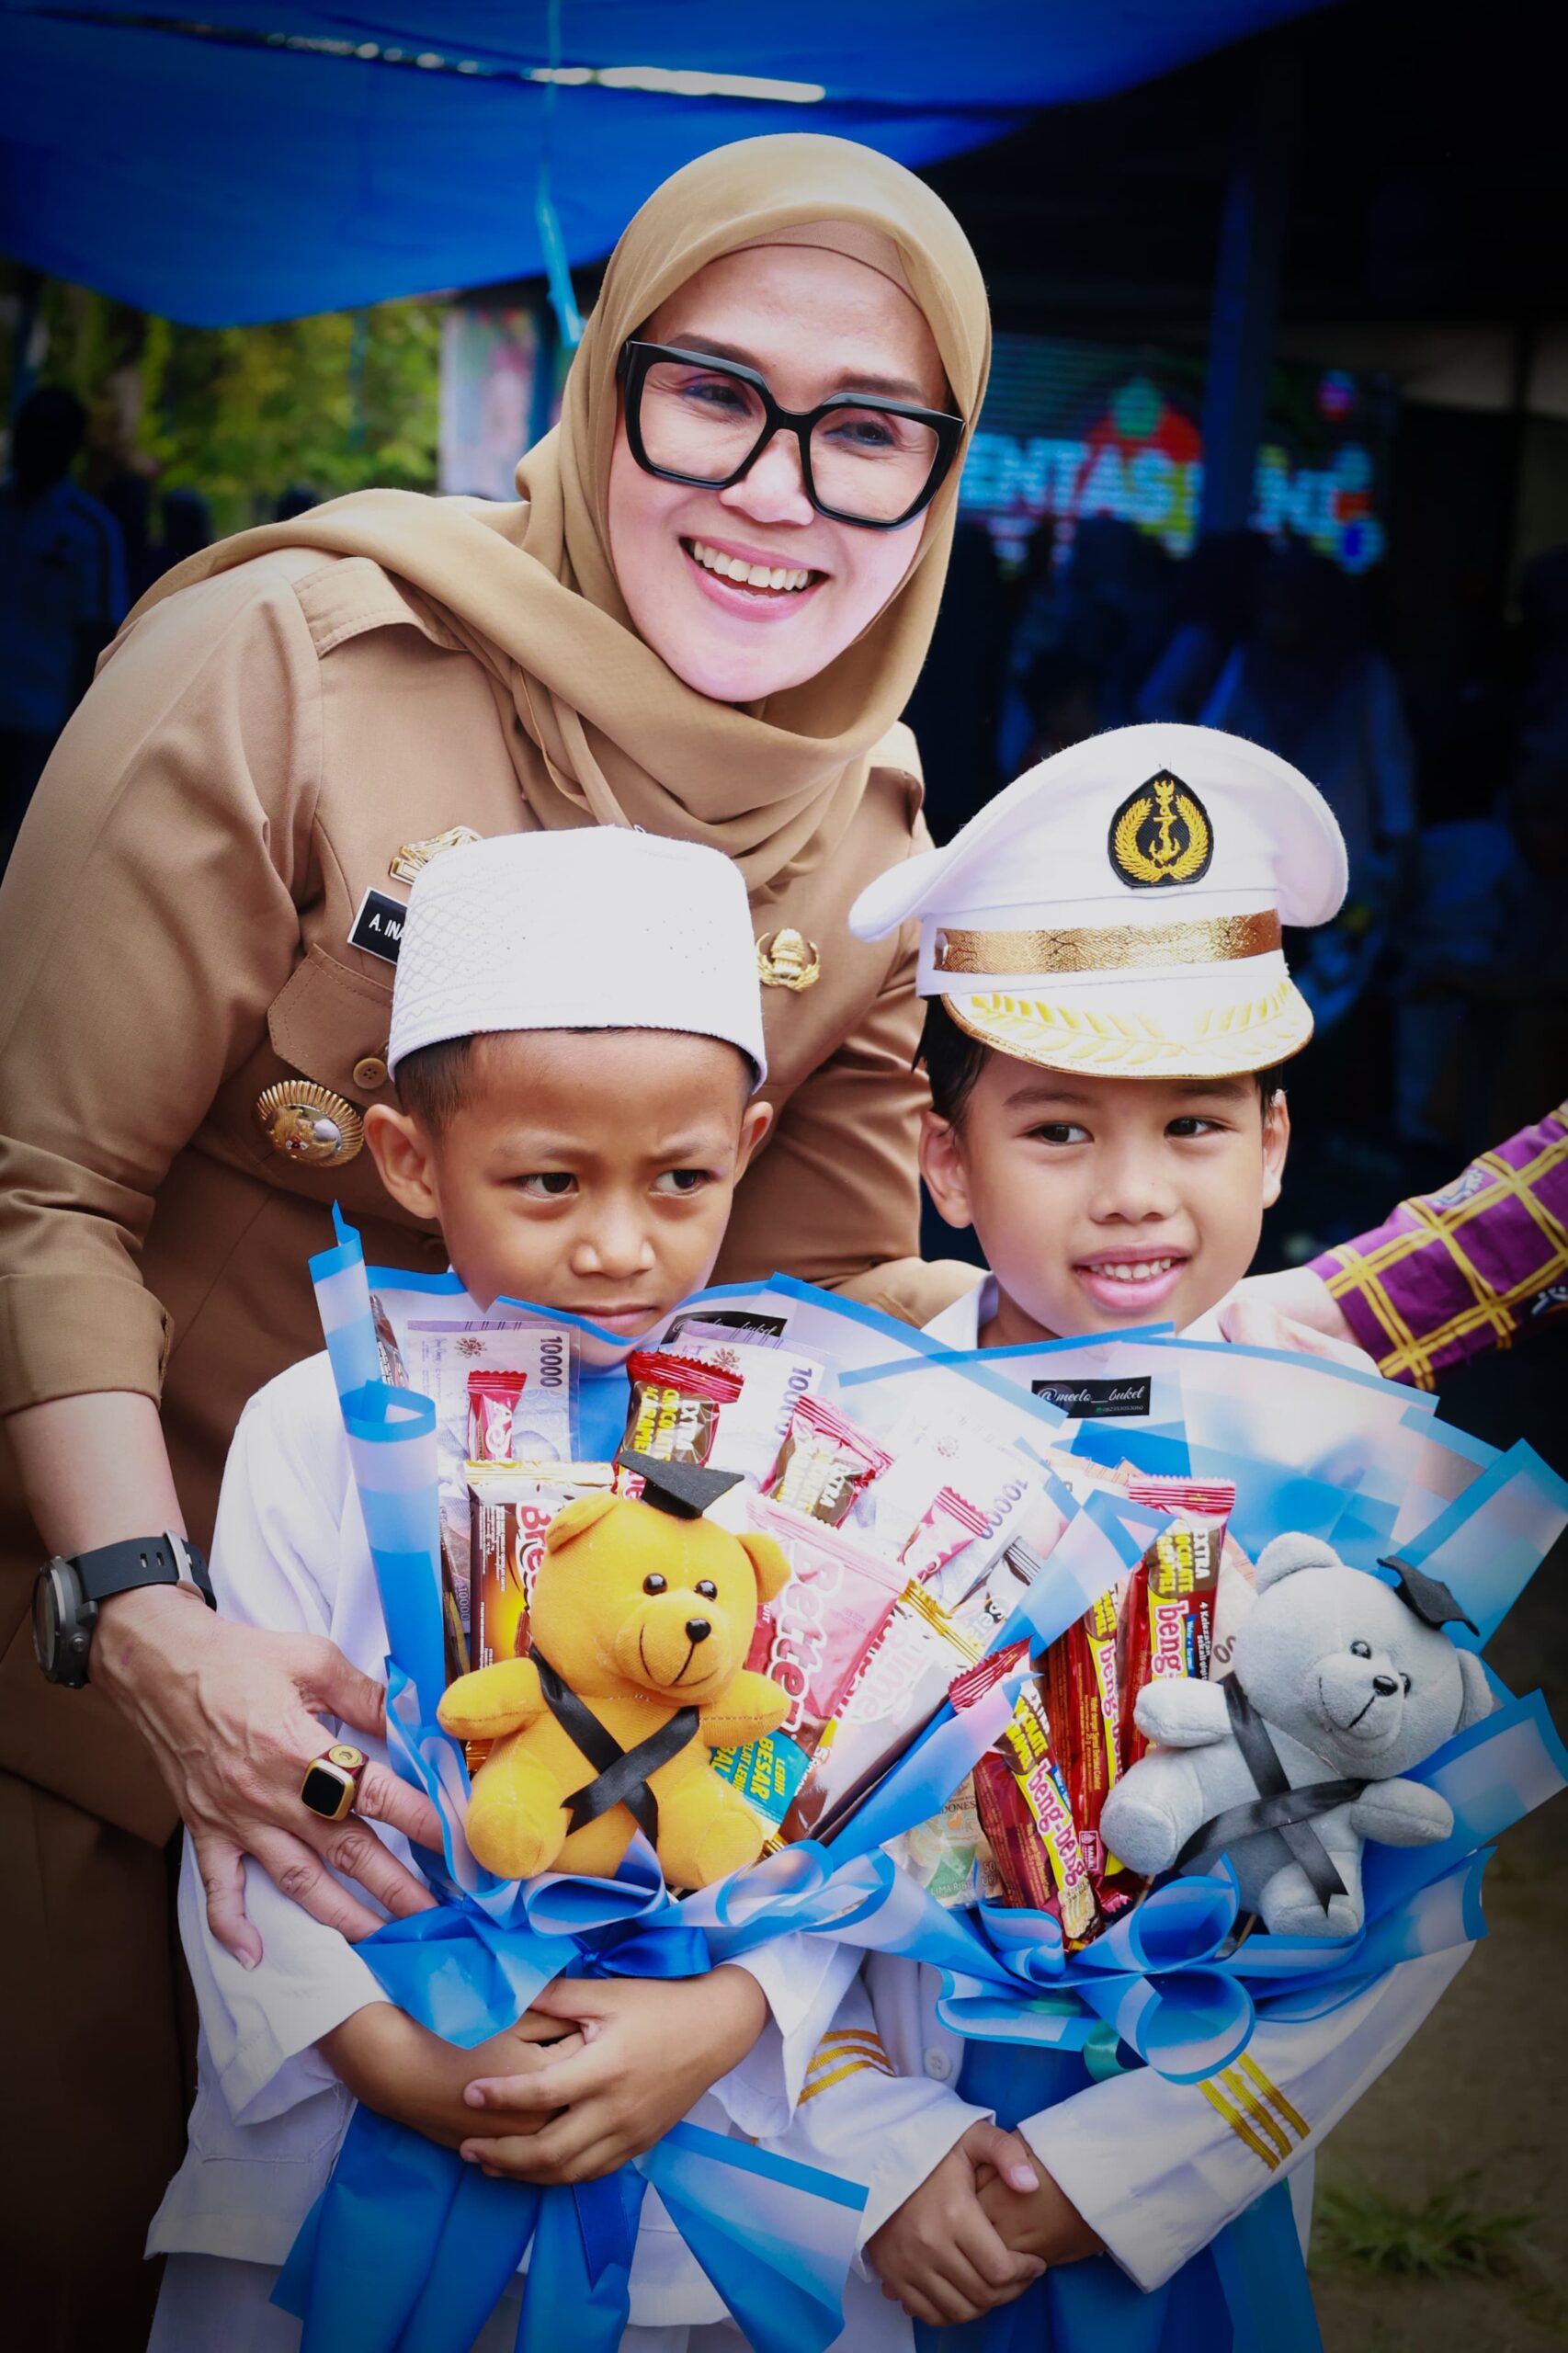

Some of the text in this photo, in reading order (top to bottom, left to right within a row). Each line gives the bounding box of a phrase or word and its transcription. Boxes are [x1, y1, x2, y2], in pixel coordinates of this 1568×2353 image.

[369, 913, 381, 931] A.
[540, 1336, 563, 1388] 10000
[520, 1505, 553, 1590] Bre
[1199, 1610, 1210, 1655] Kelezatan
[749, 1736, 774, 1801] BESAR
[773, 1757, 786, 1797] LEBIH
[1028, 1759, 1084, 1888] beng-beng
[1085, 1845, 1095, 1868] HALAL
